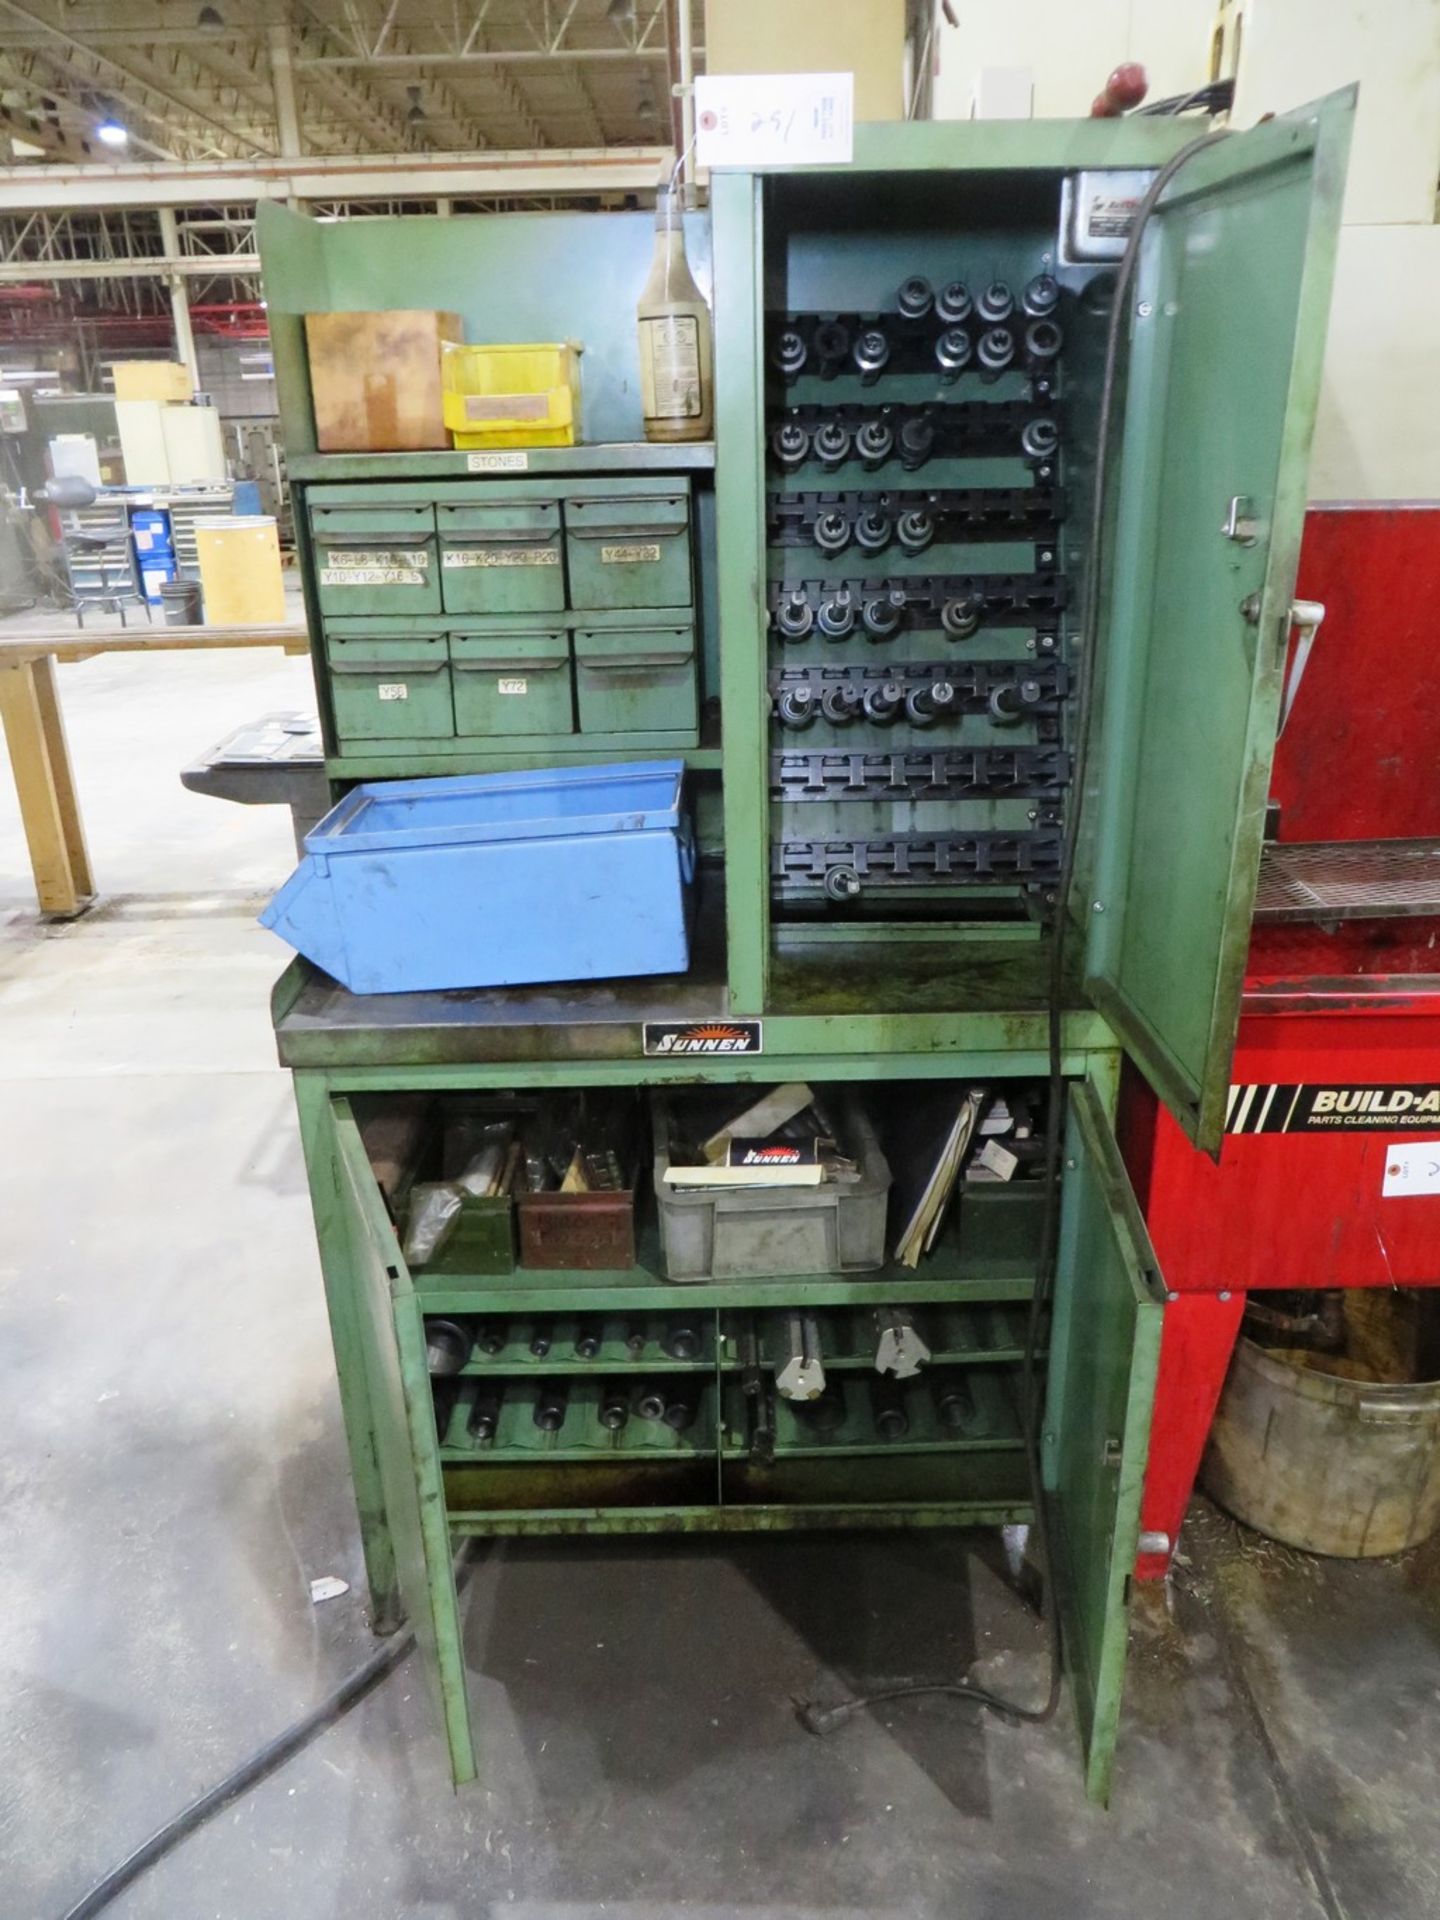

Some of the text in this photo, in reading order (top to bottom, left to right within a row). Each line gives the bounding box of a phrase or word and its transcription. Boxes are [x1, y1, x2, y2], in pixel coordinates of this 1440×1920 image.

[471, 456, 525, 468] STONES
[502, 682, 525, 692] Y72
[656, 1033, 751, 1052] SUNNEN
[1307, 1115, 1342, 1125] PARTS
[1344, 1115, 1399, 1125] CLEANING
